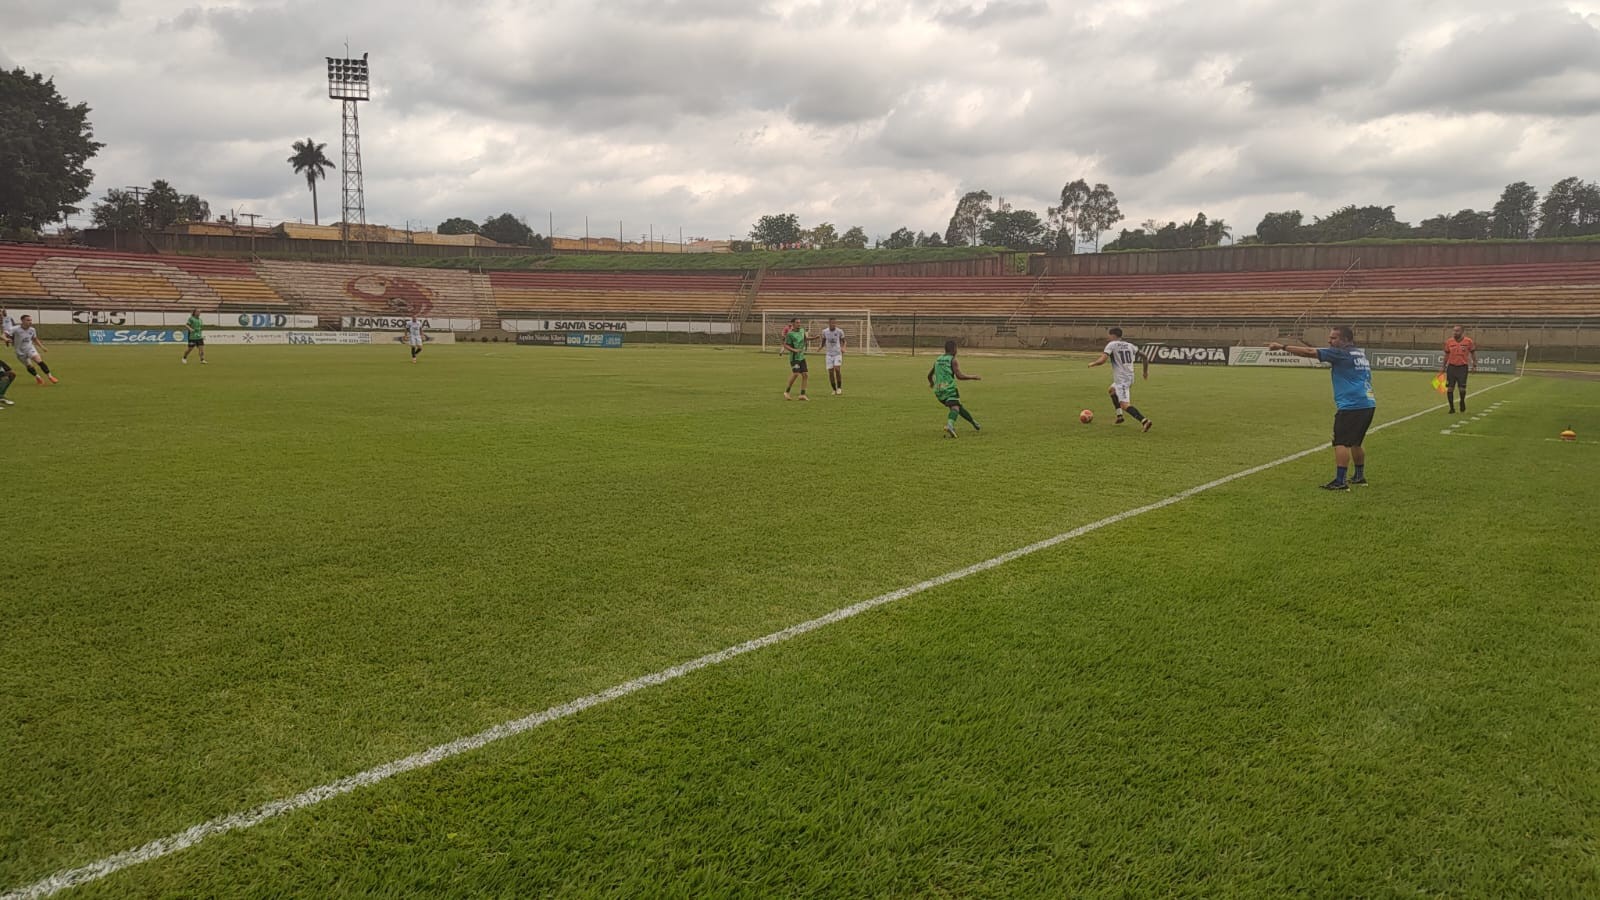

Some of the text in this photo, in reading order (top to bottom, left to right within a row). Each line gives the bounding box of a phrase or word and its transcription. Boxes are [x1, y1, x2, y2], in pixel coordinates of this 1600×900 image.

[357, 319, 389, 328] SANTA
[554, 322, 627, 330] SANTA SOPHIA
[112, 331, 166, 341] Sebal
[1118, 350, 1132, 364] 10
[1158, 347, 1225, 361] GAIVOTA
[1376, 356, 1429, 367] MERCATI
